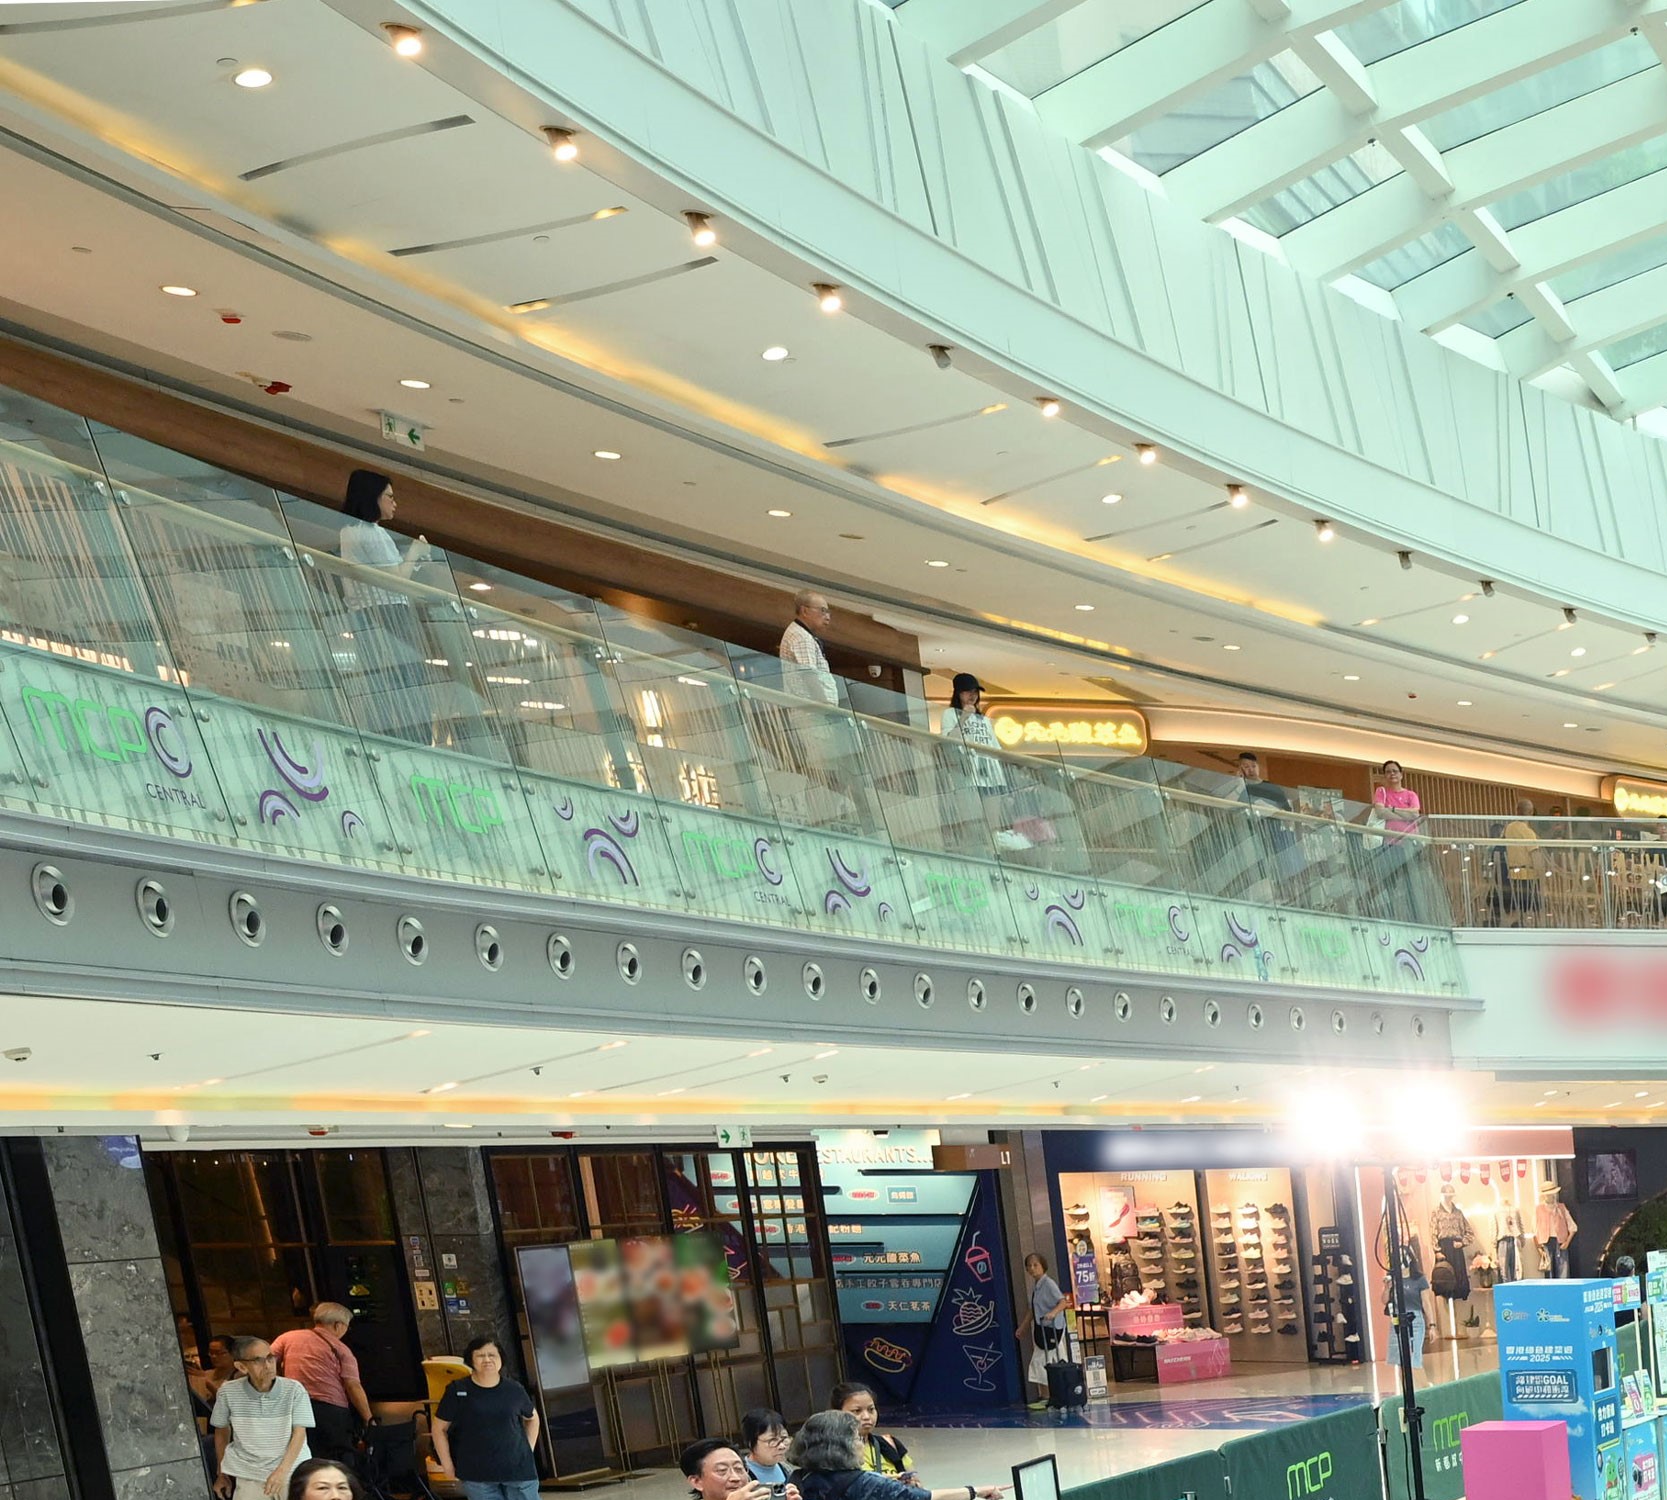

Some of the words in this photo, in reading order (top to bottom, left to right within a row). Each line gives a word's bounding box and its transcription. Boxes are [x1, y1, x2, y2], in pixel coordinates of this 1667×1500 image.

[146, 783, 206, 810] CENTRAL
[754, 891, 791, 908] CENTRAL
[1529, 1354, 1551, 1362] 2025
[1286, 1451, 1333, 1500] MCP
